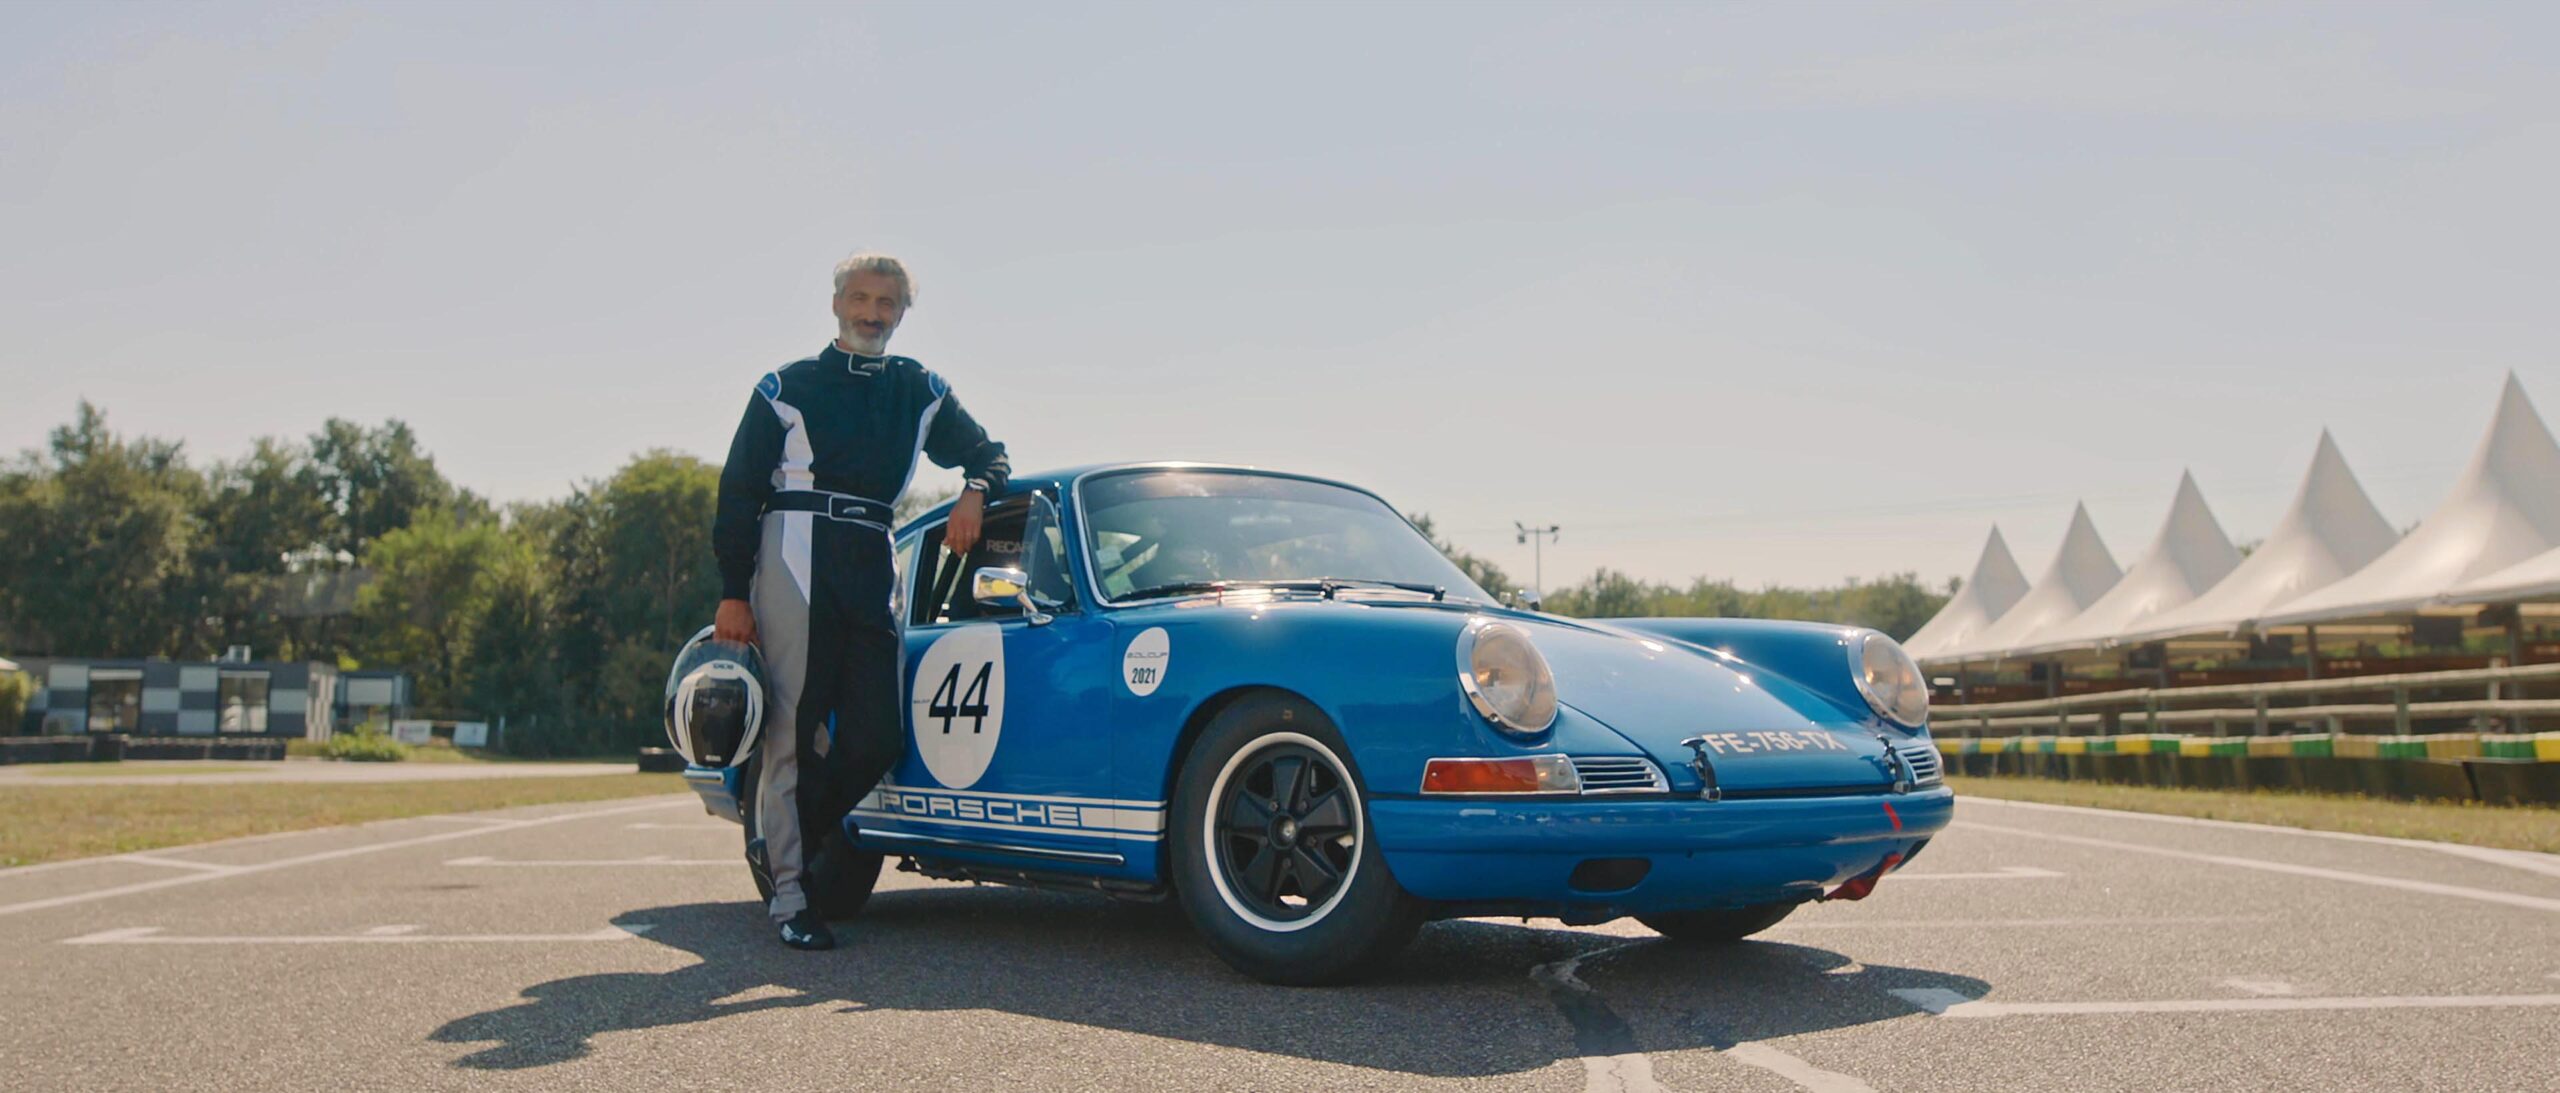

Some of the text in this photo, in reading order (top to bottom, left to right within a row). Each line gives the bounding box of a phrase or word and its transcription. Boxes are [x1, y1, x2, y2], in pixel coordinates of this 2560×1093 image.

[1131, 667, 1156, 684] 2021
[928, 661, 993, 734] 44
[880, 793, 1079, 826] PORSCHE
